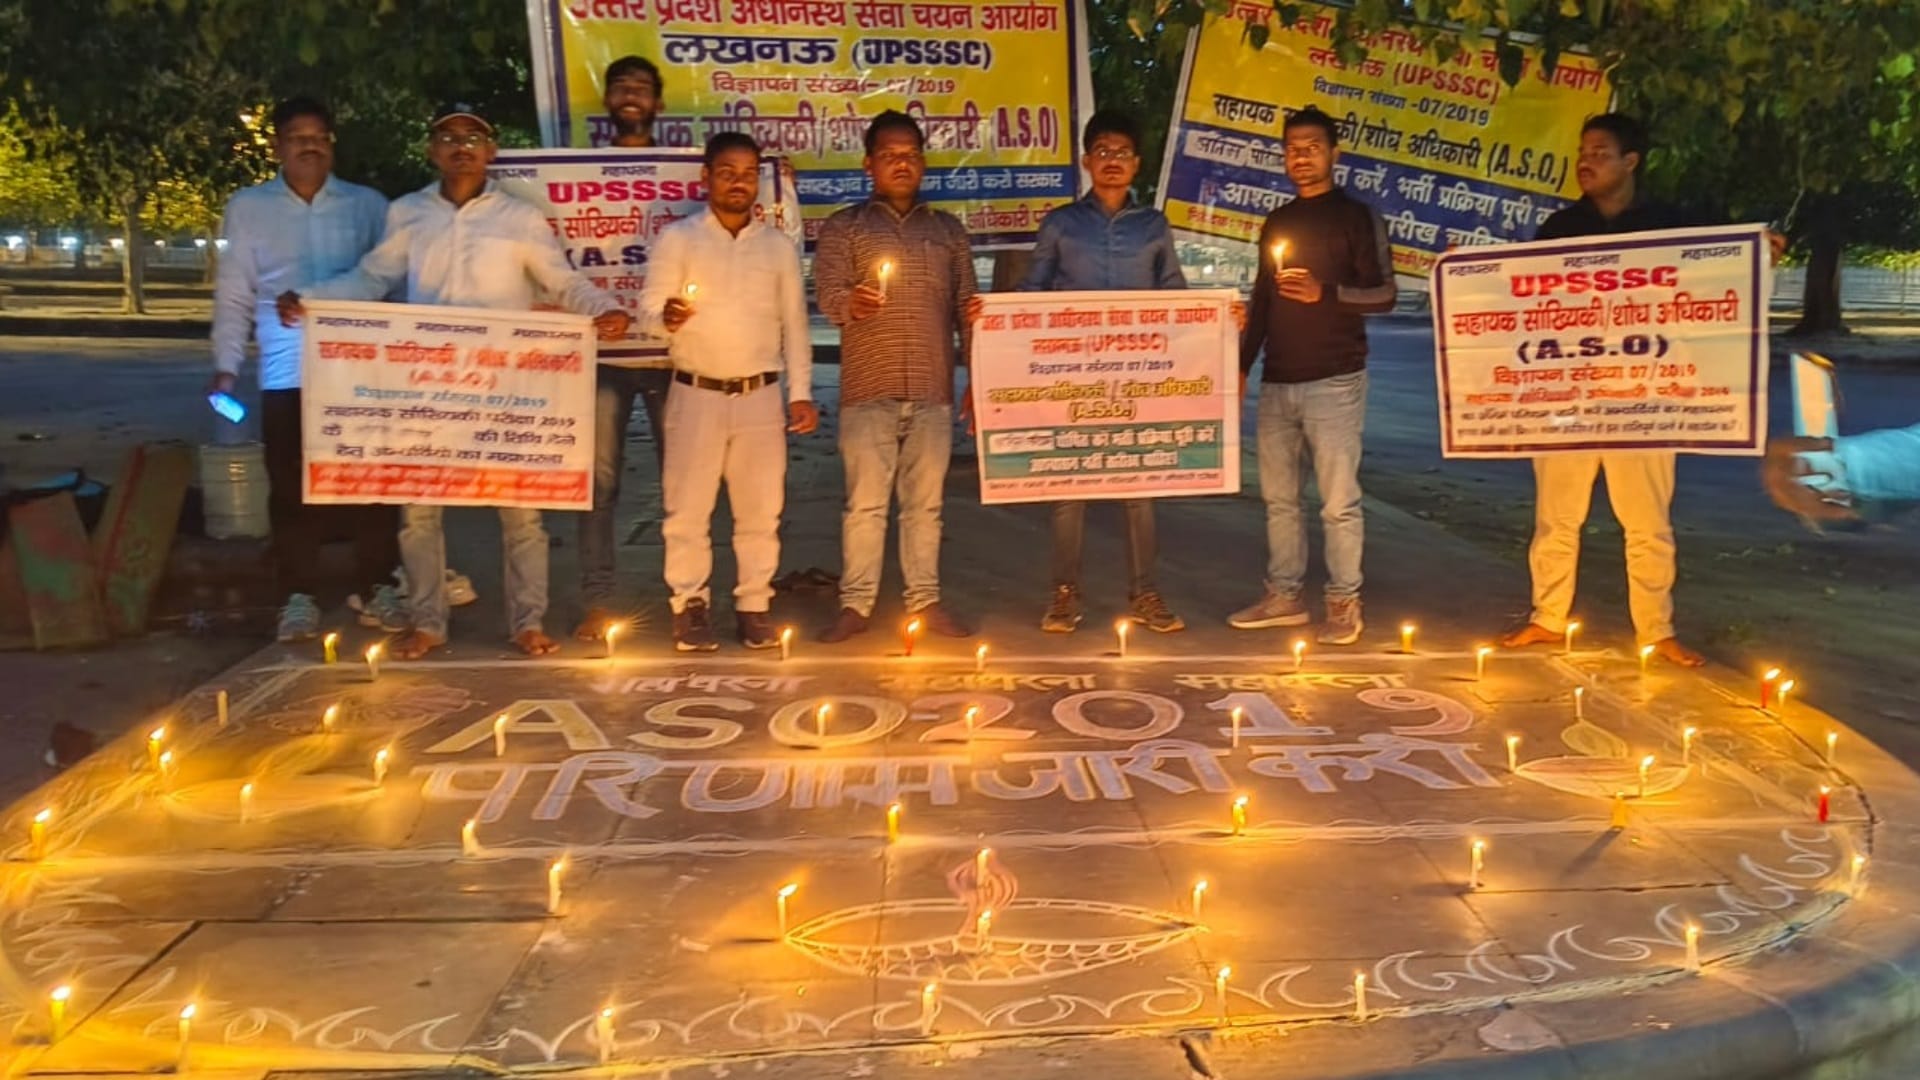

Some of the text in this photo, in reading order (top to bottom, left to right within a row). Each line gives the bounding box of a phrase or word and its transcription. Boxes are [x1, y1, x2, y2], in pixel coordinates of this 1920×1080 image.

[914, 3, 972, 28] चयन
[981, 2, 1057, 30] आयोग
[661, 34, 991, 69] लखनऊ (UPSSSC)
[712, 71, 799, 91] विज्ञापन
[1394, 62, 1499, 105] (UPSSSC)
[1213, 94, 1278, 125] सहायक
[1408, 127, 1482, 170] अधिकारी
[1511, 266, 1678, 297] UPSSSC
[1452, 311, 1518, 335] सहायक
[1656, 289, 1739, 325] अधिकारी
[1517, 334, 1669, 364] (A.S.O)
